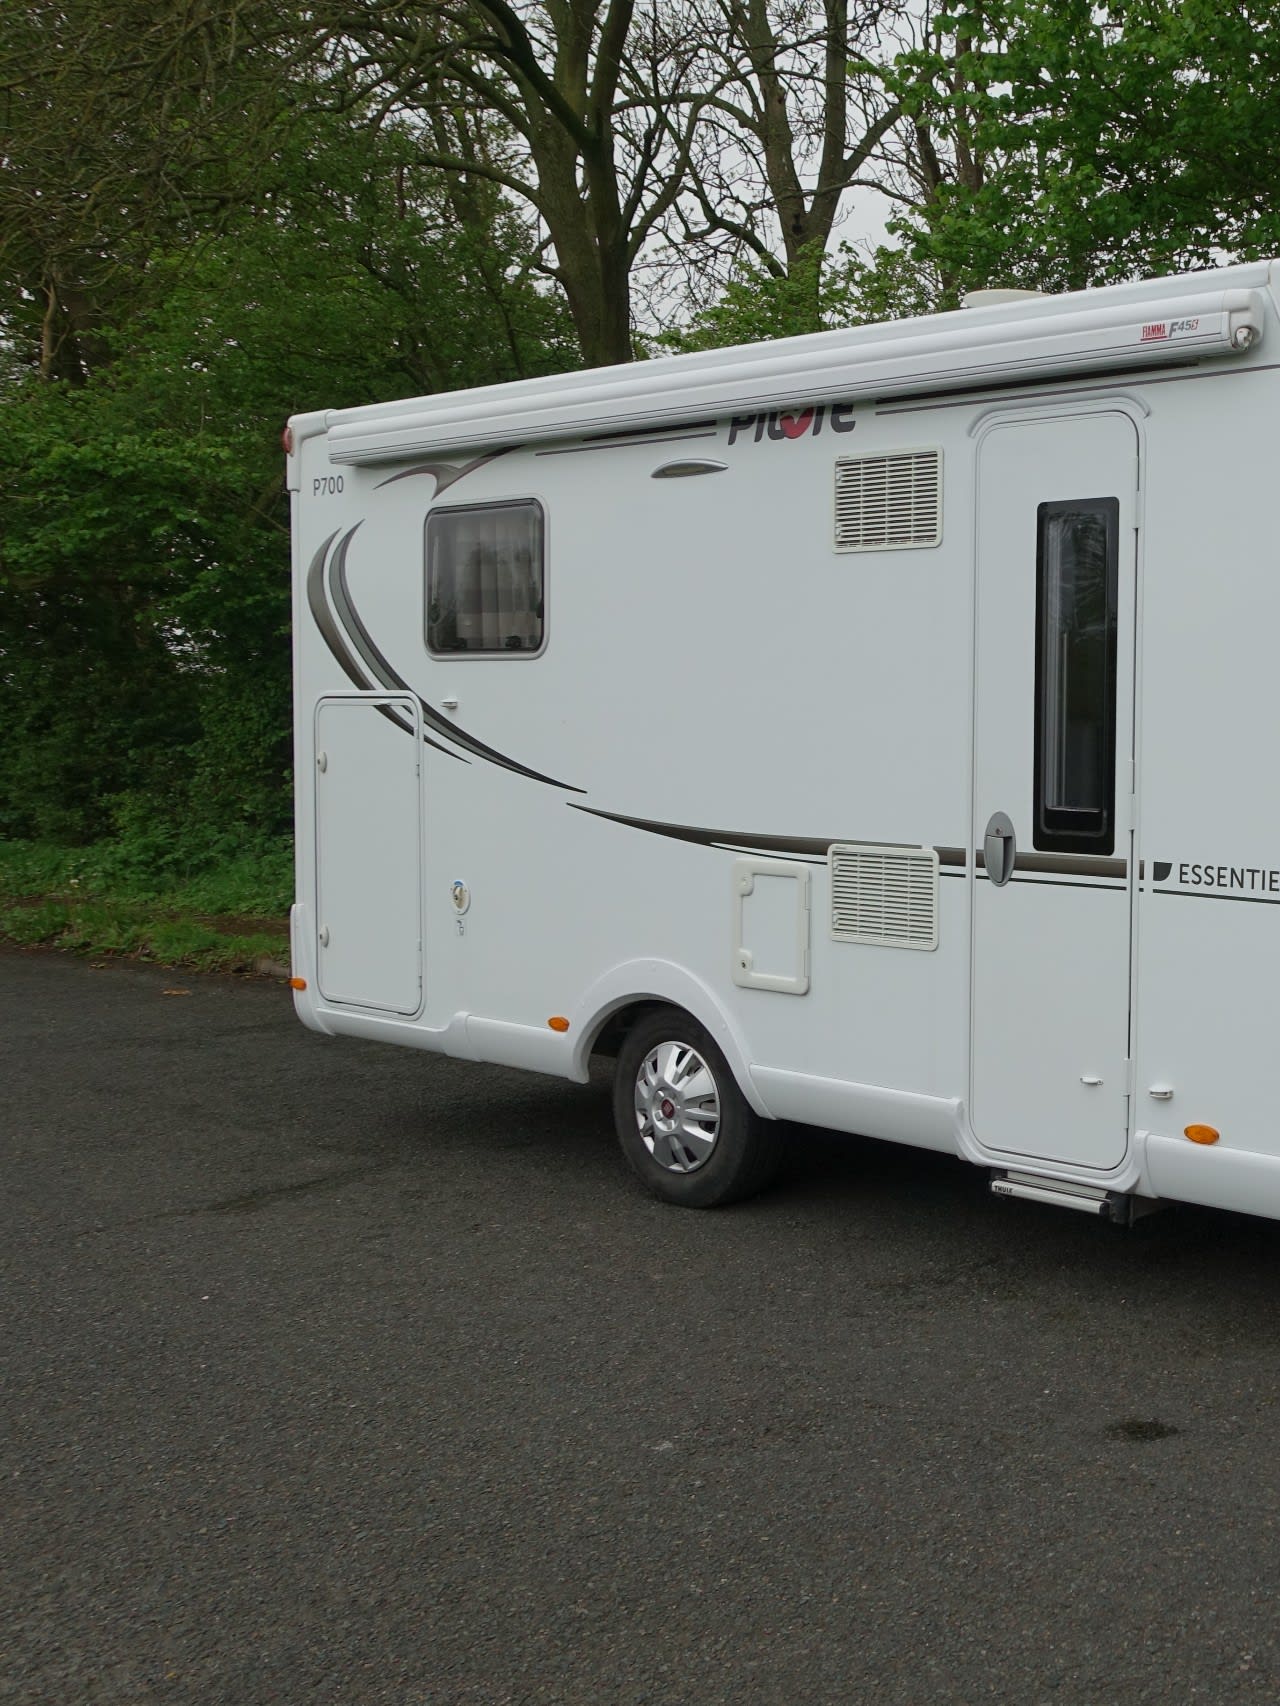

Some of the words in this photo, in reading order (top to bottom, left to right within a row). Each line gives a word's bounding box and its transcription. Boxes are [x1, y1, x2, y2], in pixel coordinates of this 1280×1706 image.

[1142, 323, 1166, 338] FIAMMA
[313, 475, 344, 497] P700
[994, 1185, 1014, 1194] THULE
